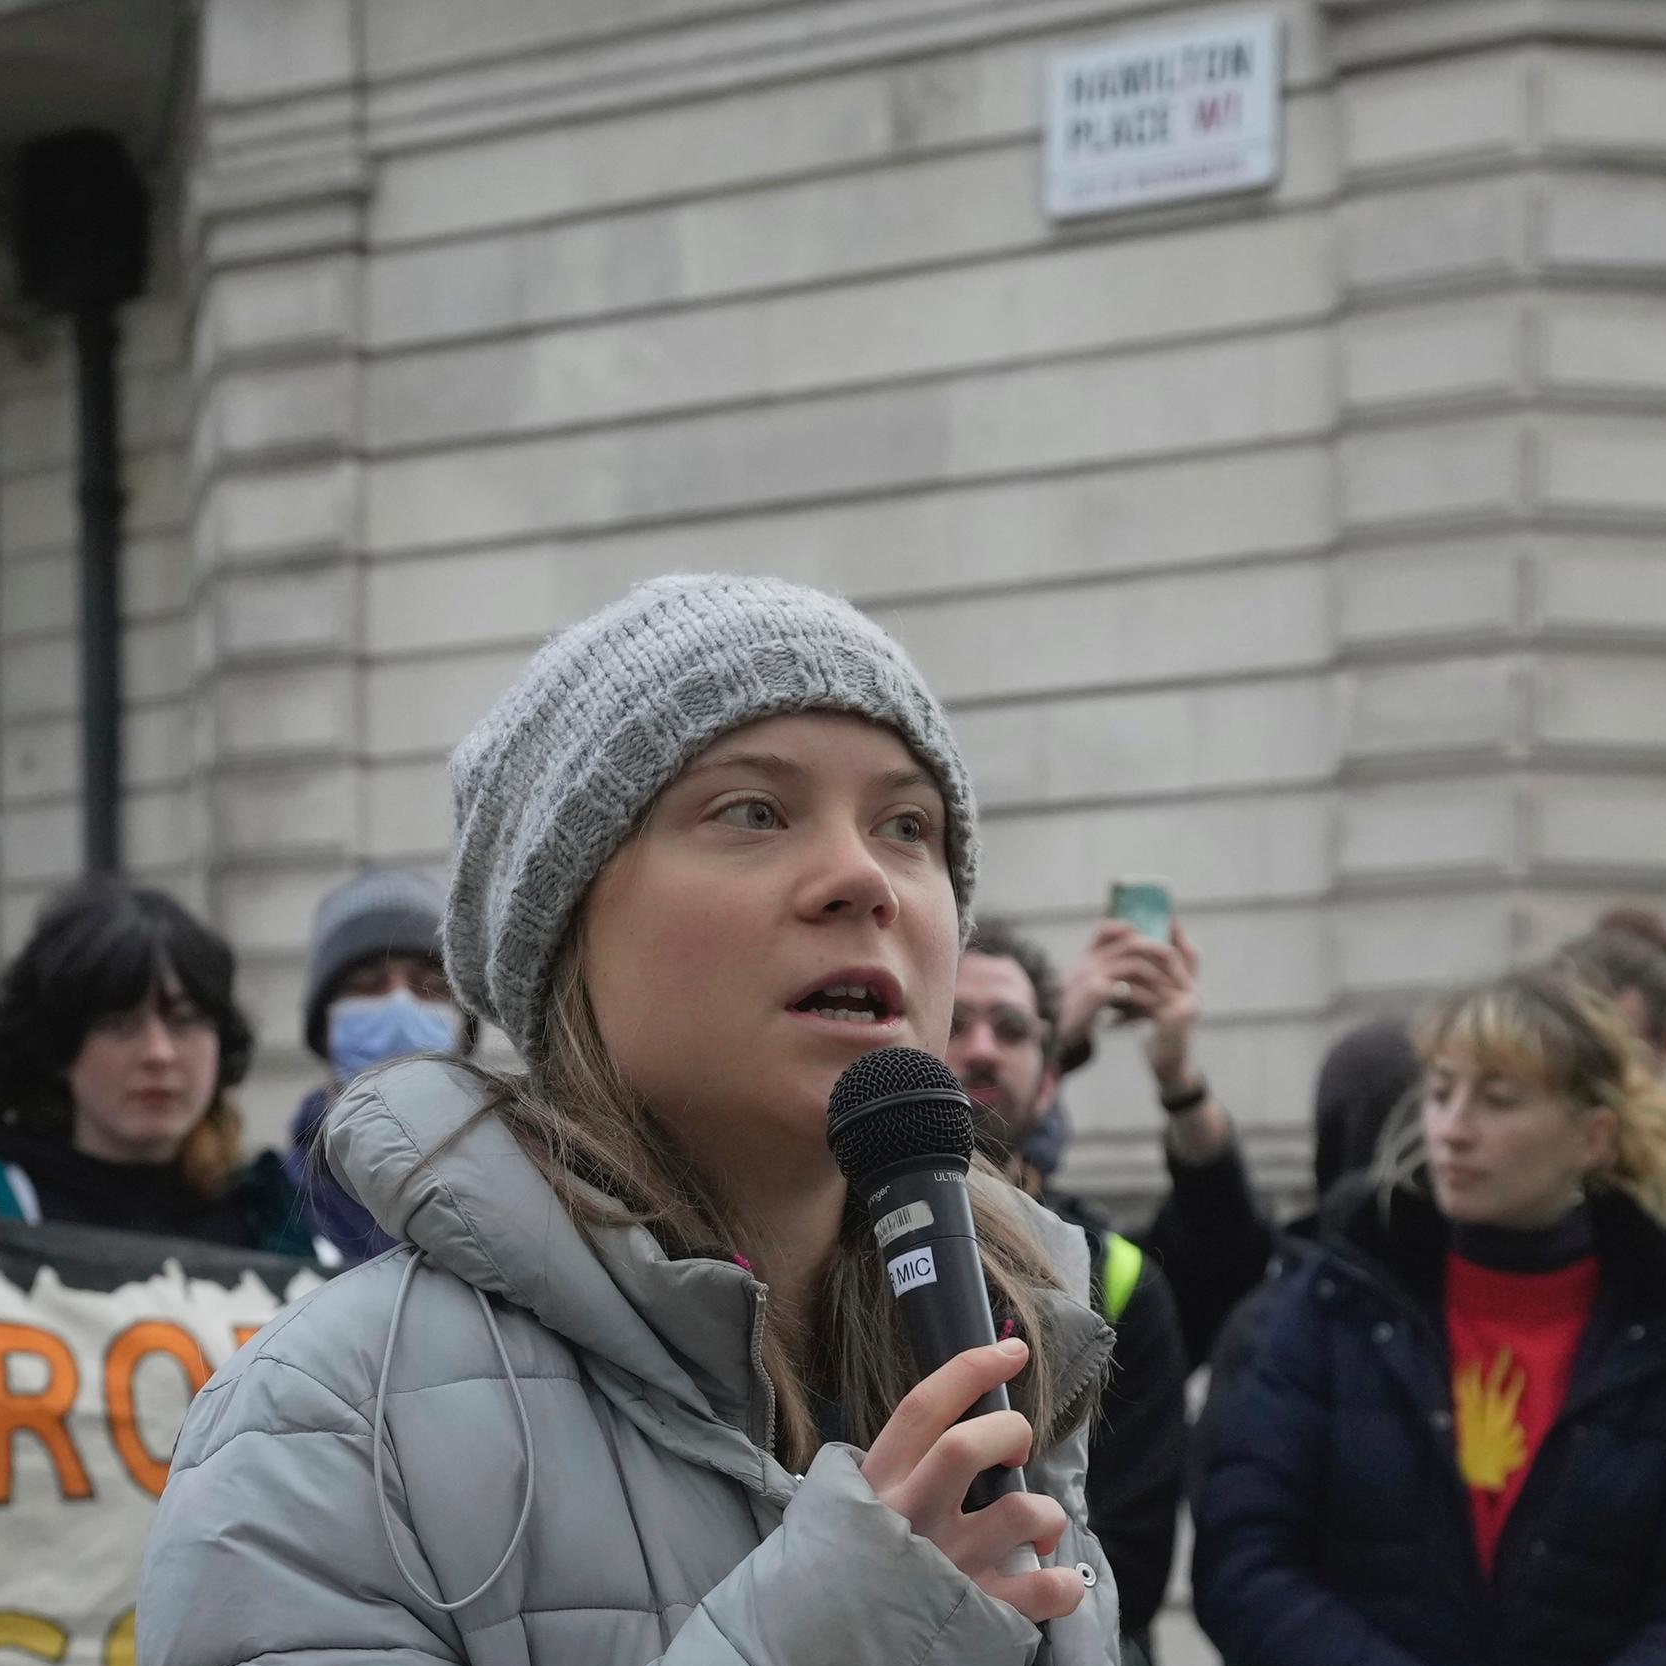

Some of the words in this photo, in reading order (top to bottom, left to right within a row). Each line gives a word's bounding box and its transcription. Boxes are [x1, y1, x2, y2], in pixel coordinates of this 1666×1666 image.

[1070, 42, 1252, 103] HAMILTON
[1069, 104, 1169, 150] PLACE
[896, 1257, 931, 1285] MIC
